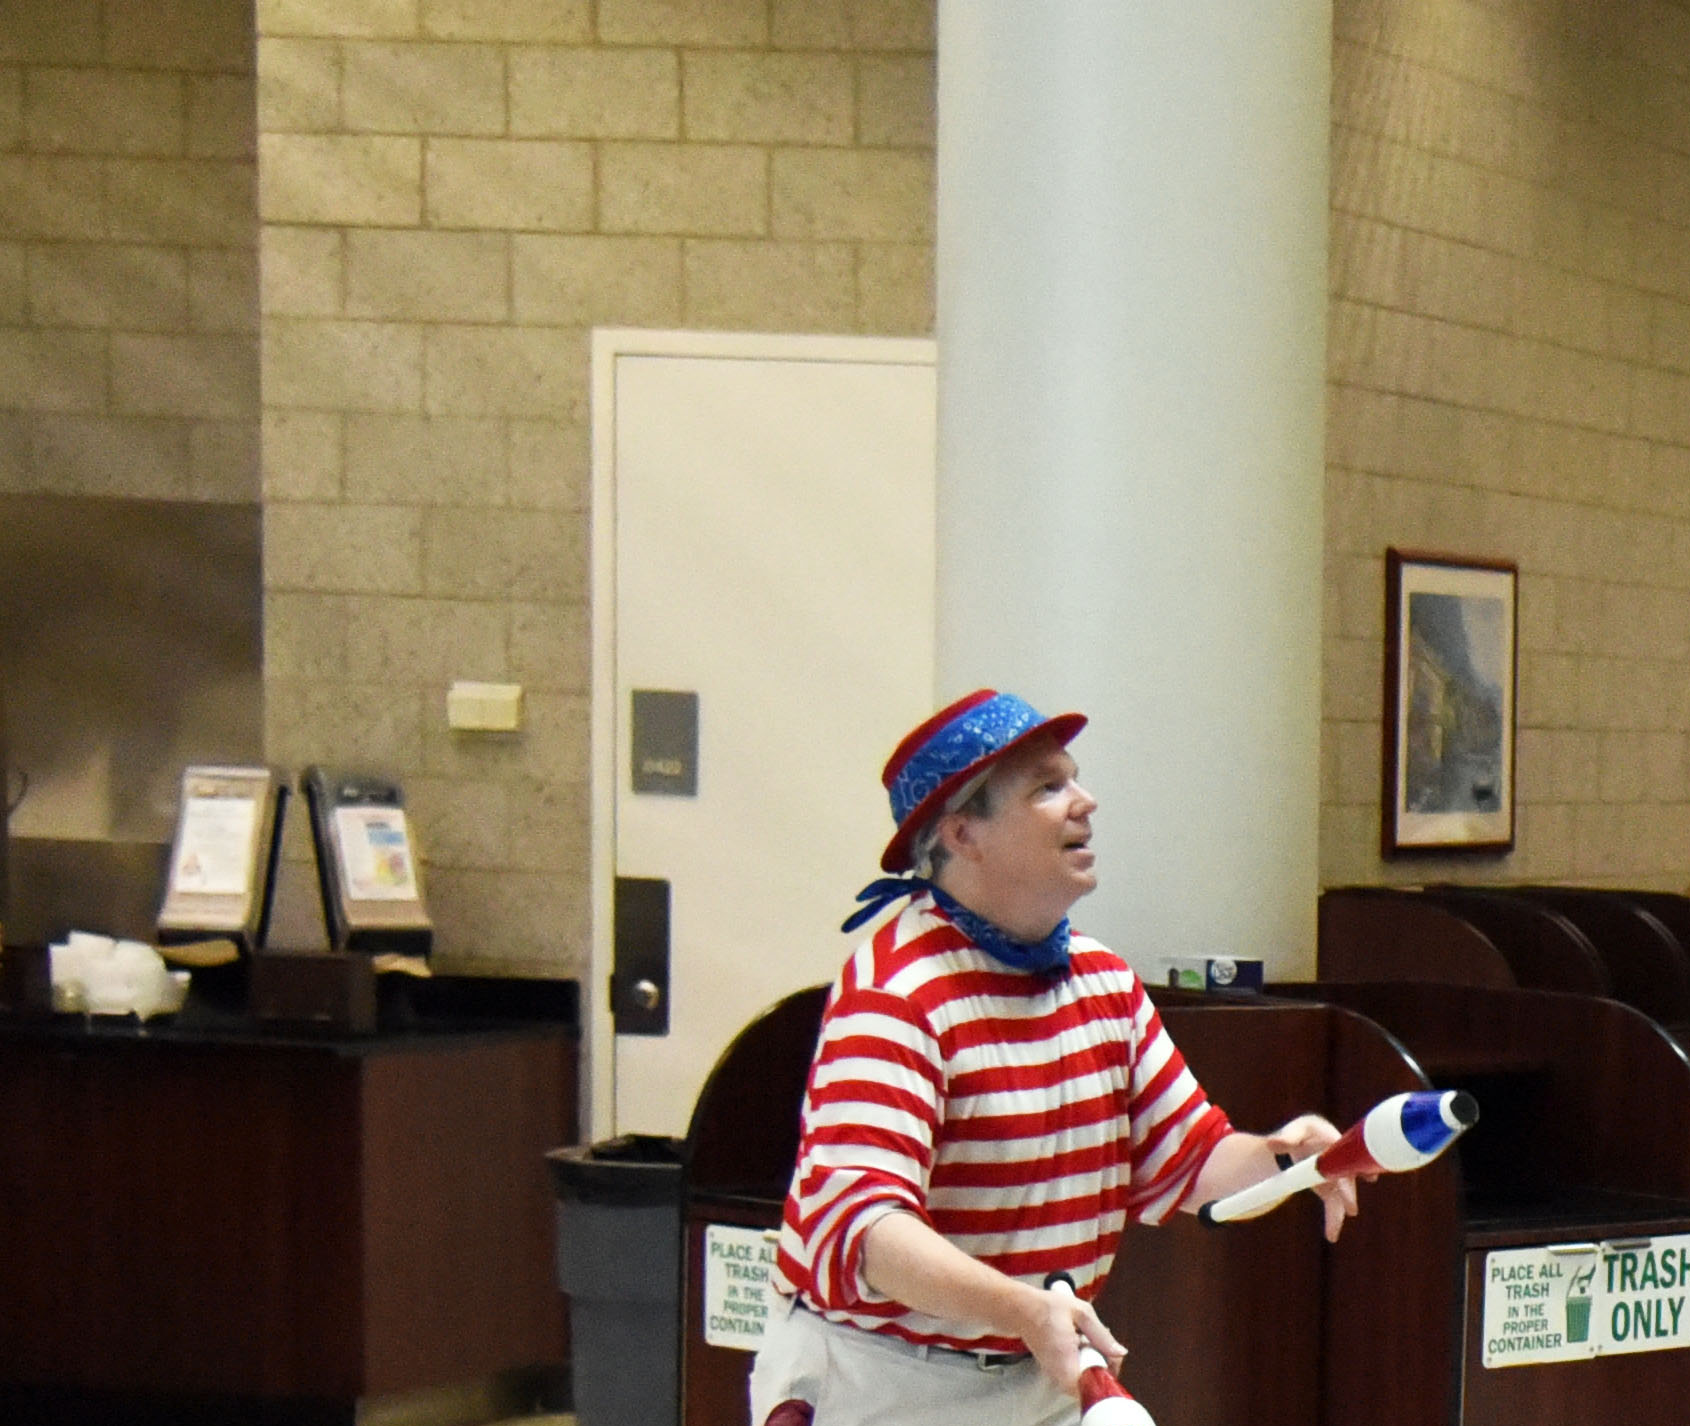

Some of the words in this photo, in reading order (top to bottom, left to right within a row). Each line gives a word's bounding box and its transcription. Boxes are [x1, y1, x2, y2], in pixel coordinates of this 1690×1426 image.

[711, 1242, 752, 1261] PLACE
[725, 1263, 769, 1282] TRASH
[1491, 1264, 1535, 1283] PLACE
[1539, 1263, 1564, 1279] ALL
[1505, 1282, 1550, 1300] TRASH
[1508, 1306, 1519, 1318] IN
[1524, 1303, 1545, 1317] THE
[1611, 1296, 1686, 1342] ONLY
[1503, 1319, 1548, 1336] PROPER
[1488, 1333, 1562, 1354] CONTAINER
